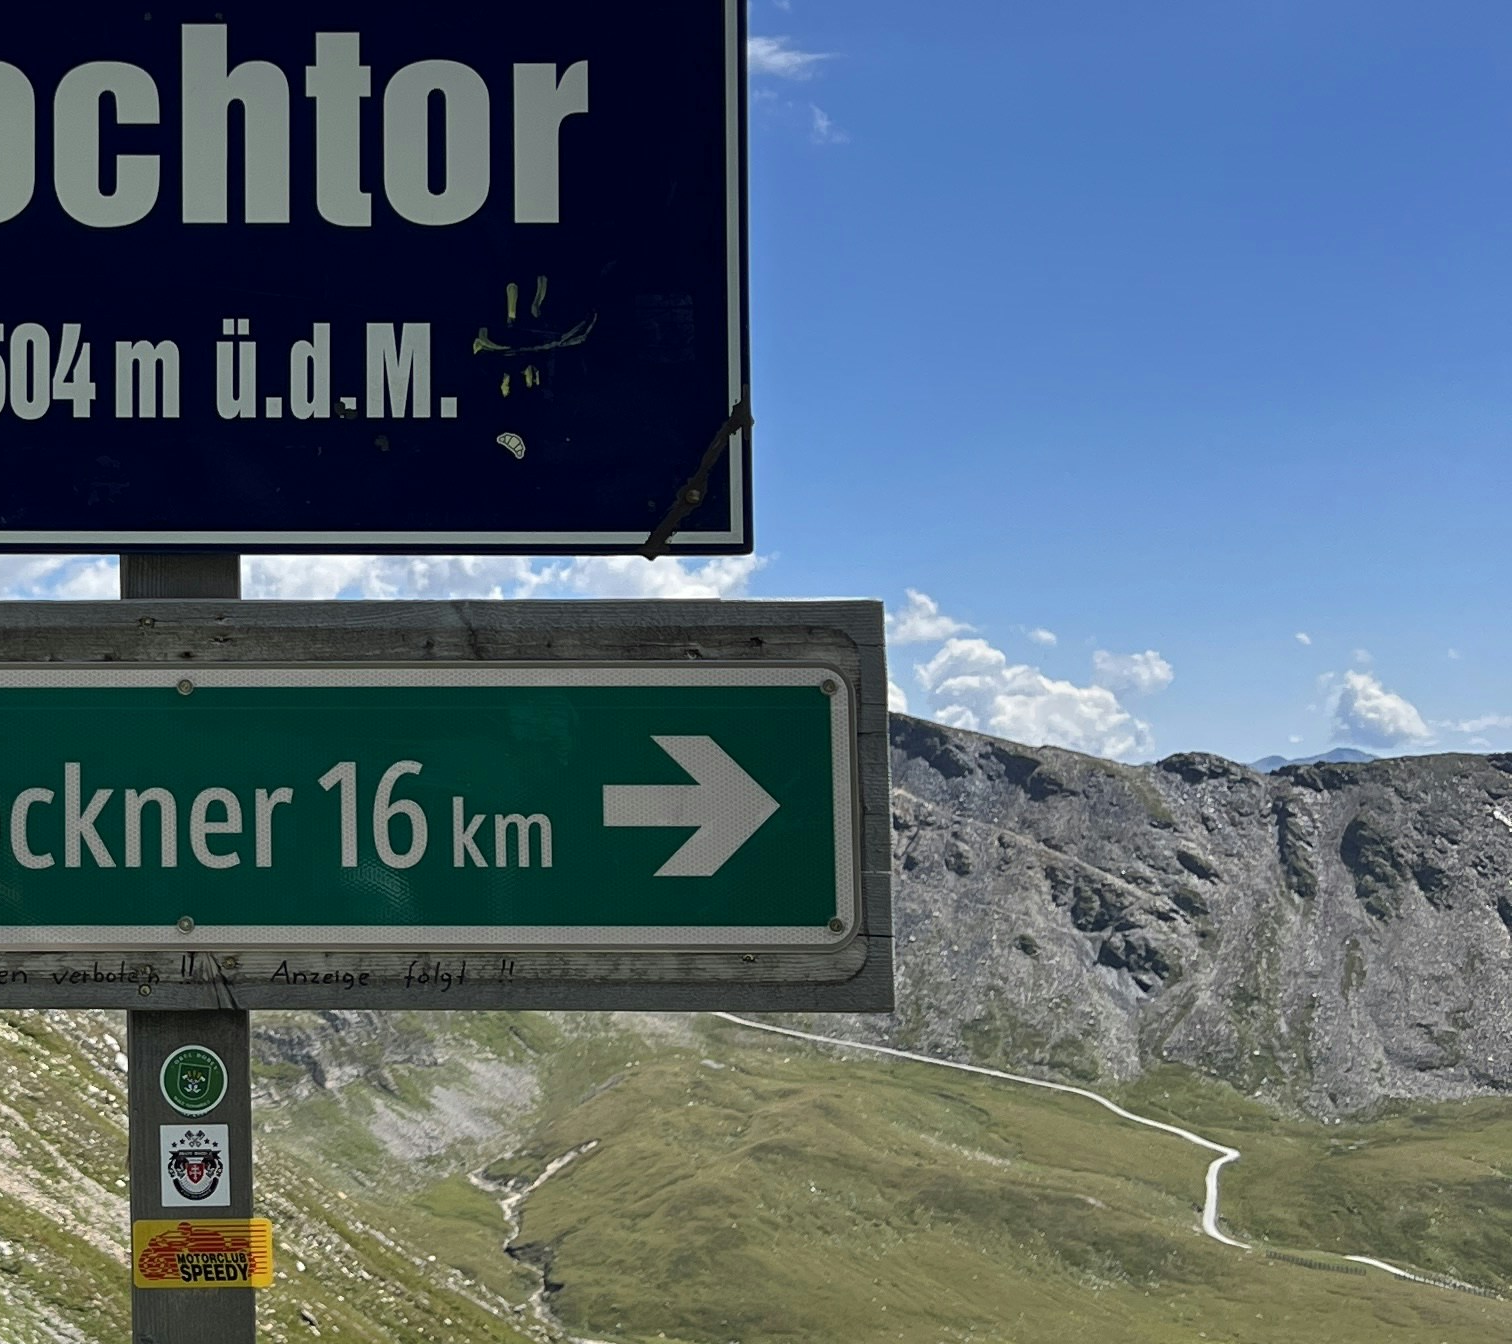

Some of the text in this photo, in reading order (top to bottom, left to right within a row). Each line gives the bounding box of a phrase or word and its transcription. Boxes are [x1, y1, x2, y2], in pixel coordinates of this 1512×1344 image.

[116, 335, 180, 418] m
[216, 318, 458, 419] ü.d.M.
[319, 760, 430, 869] 16
[454, 794, 553, 868] km
[52, 960, 160, 985] verboten
[270, 960, 370, 989] Anzeige
[404, 960, 466, 992] folgt
[176, 1253, 247, 1264] MOTORCLUB
[179, 1264, 251, 1283] SPEEDY
